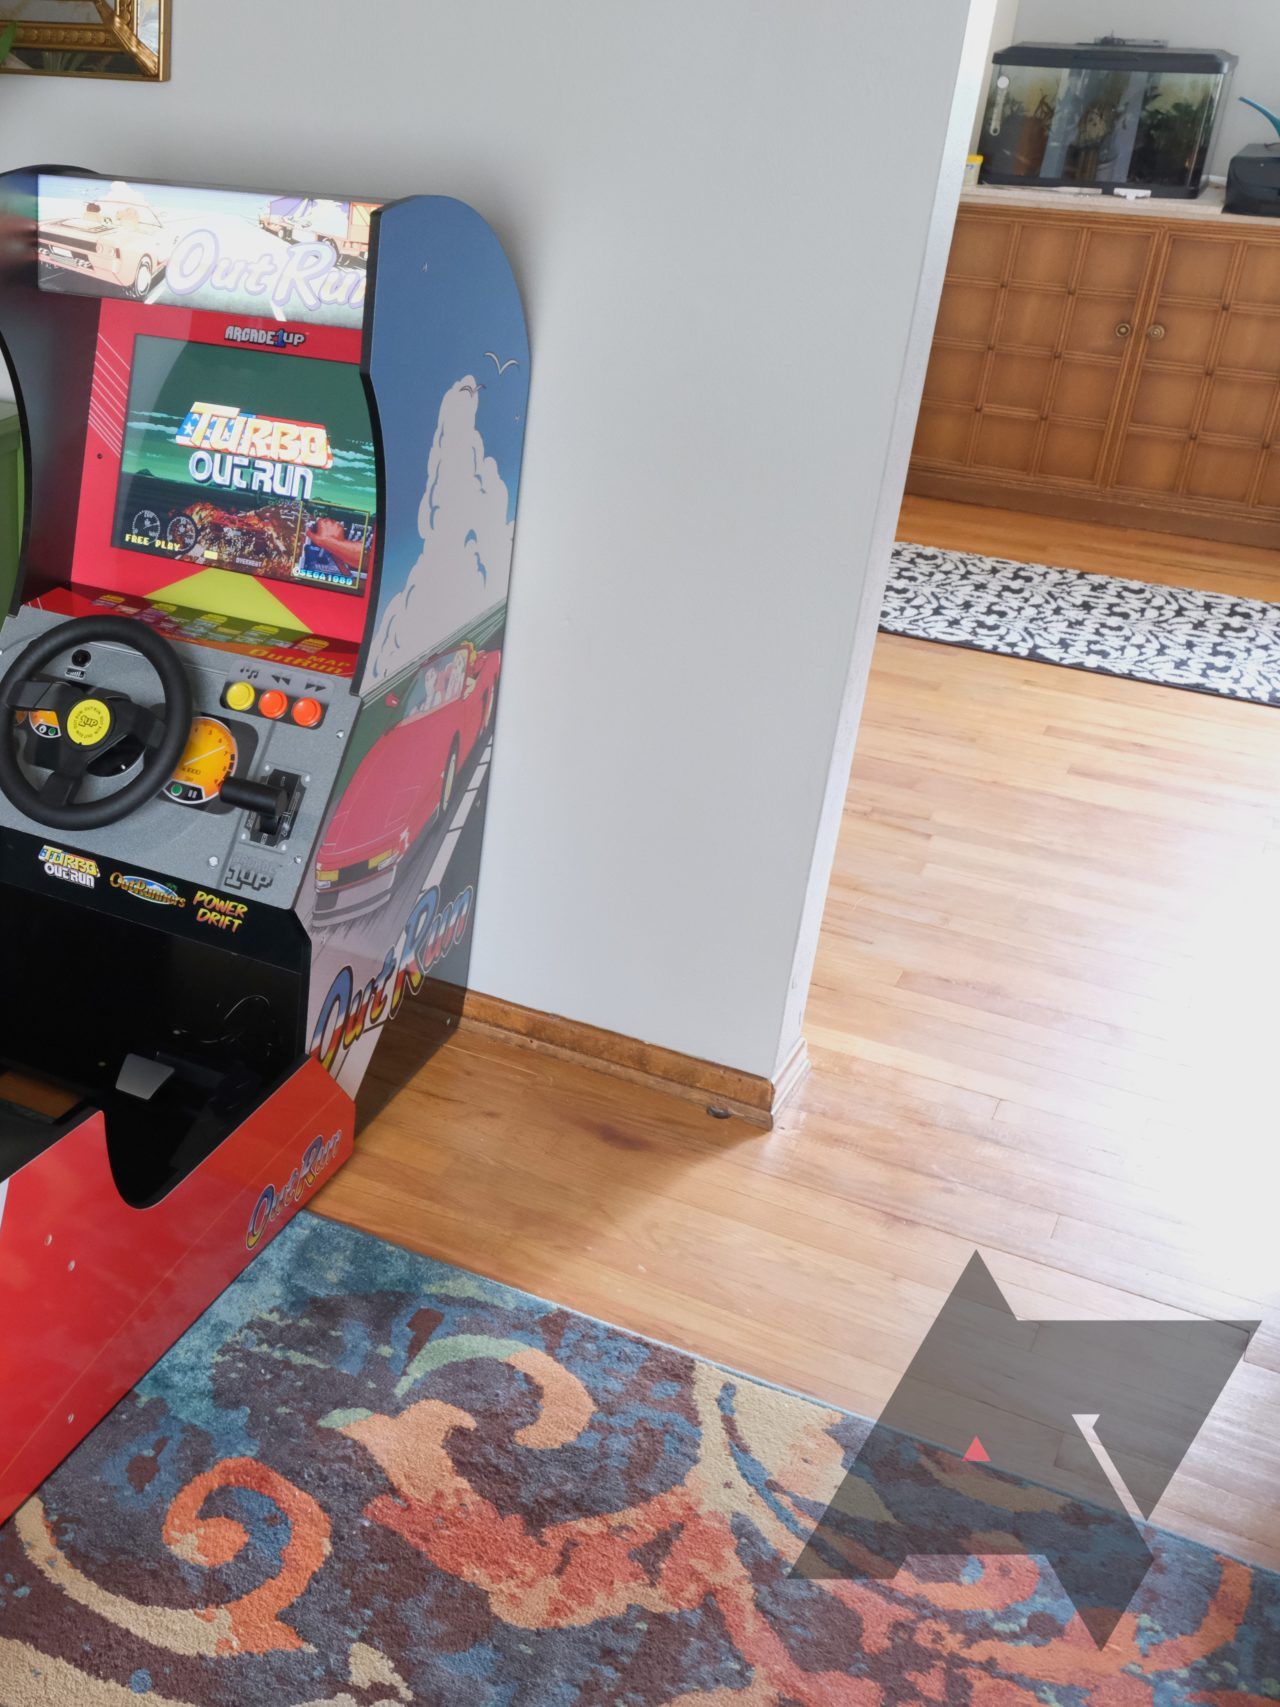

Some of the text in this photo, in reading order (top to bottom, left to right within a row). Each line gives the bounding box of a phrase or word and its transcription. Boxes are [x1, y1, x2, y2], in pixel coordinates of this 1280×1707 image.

[188, 401, 330, 468] TURBO
[125, 533, 150, 545] FREE
[155, 539, 180, 552] PLAY
[42, 845, 100, 878] TURBO
[193, 890, 249, 918] POWER
[196, 908, 243, 933] DRIFT
